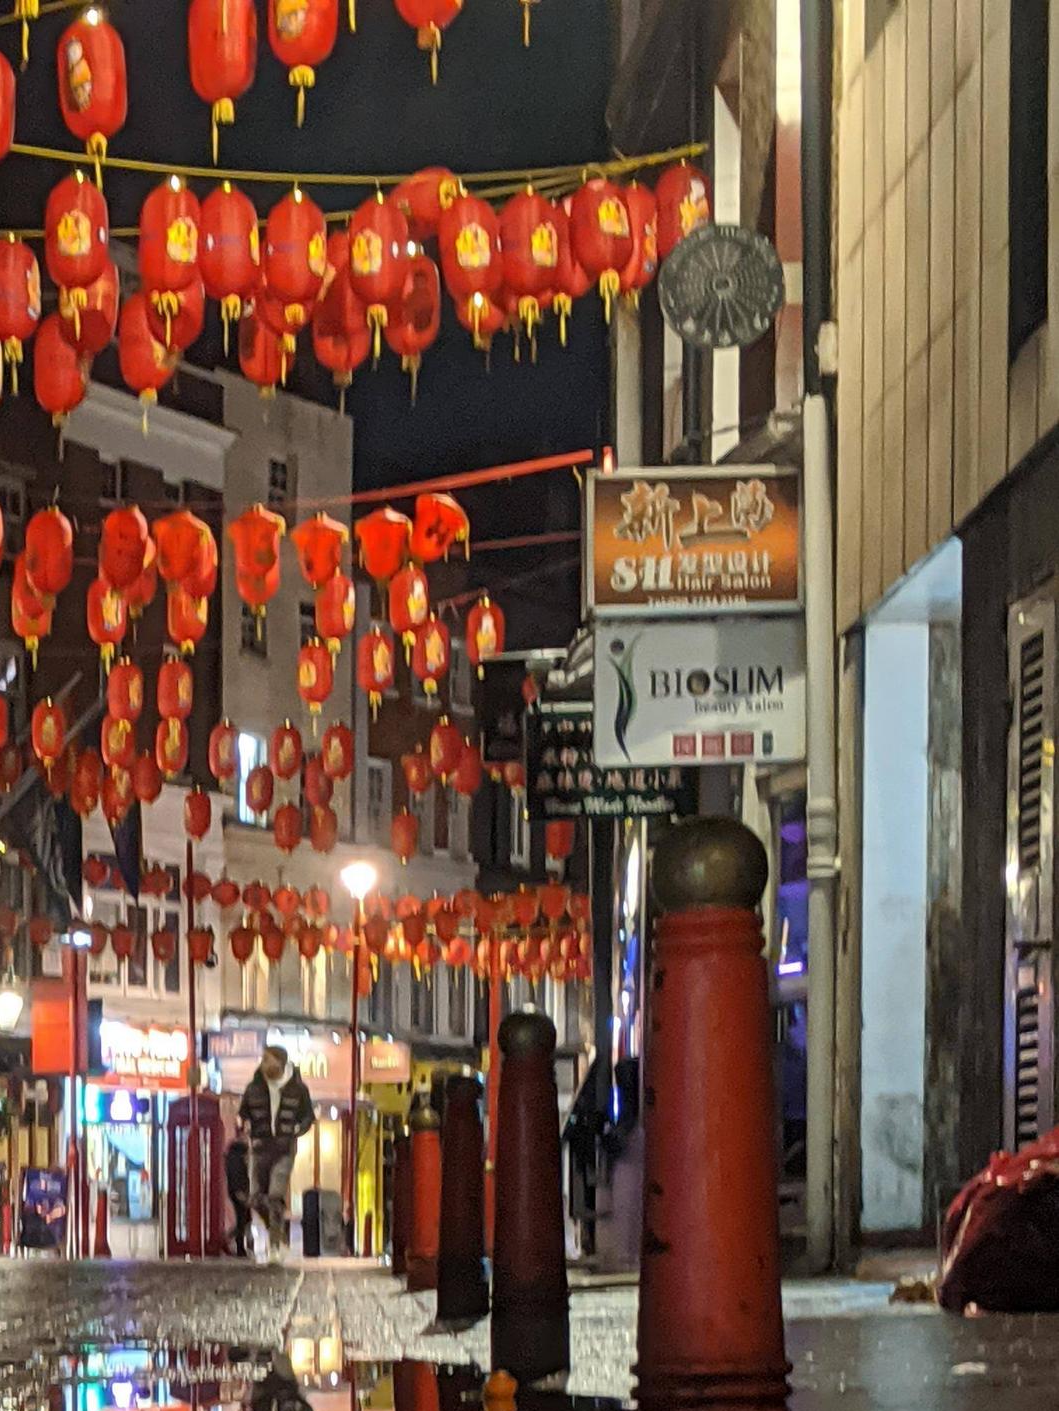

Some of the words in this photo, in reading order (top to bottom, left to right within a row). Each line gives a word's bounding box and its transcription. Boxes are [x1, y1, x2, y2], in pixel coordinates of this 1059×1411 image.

[677, 573, 714, 591] Hair
[720, 572, 772, 590] Salon
[649, 664, 785, 699] BIOSLIM
[694, 698, 739, 714] Beauty
[745, 696, 785, 713] Salon
